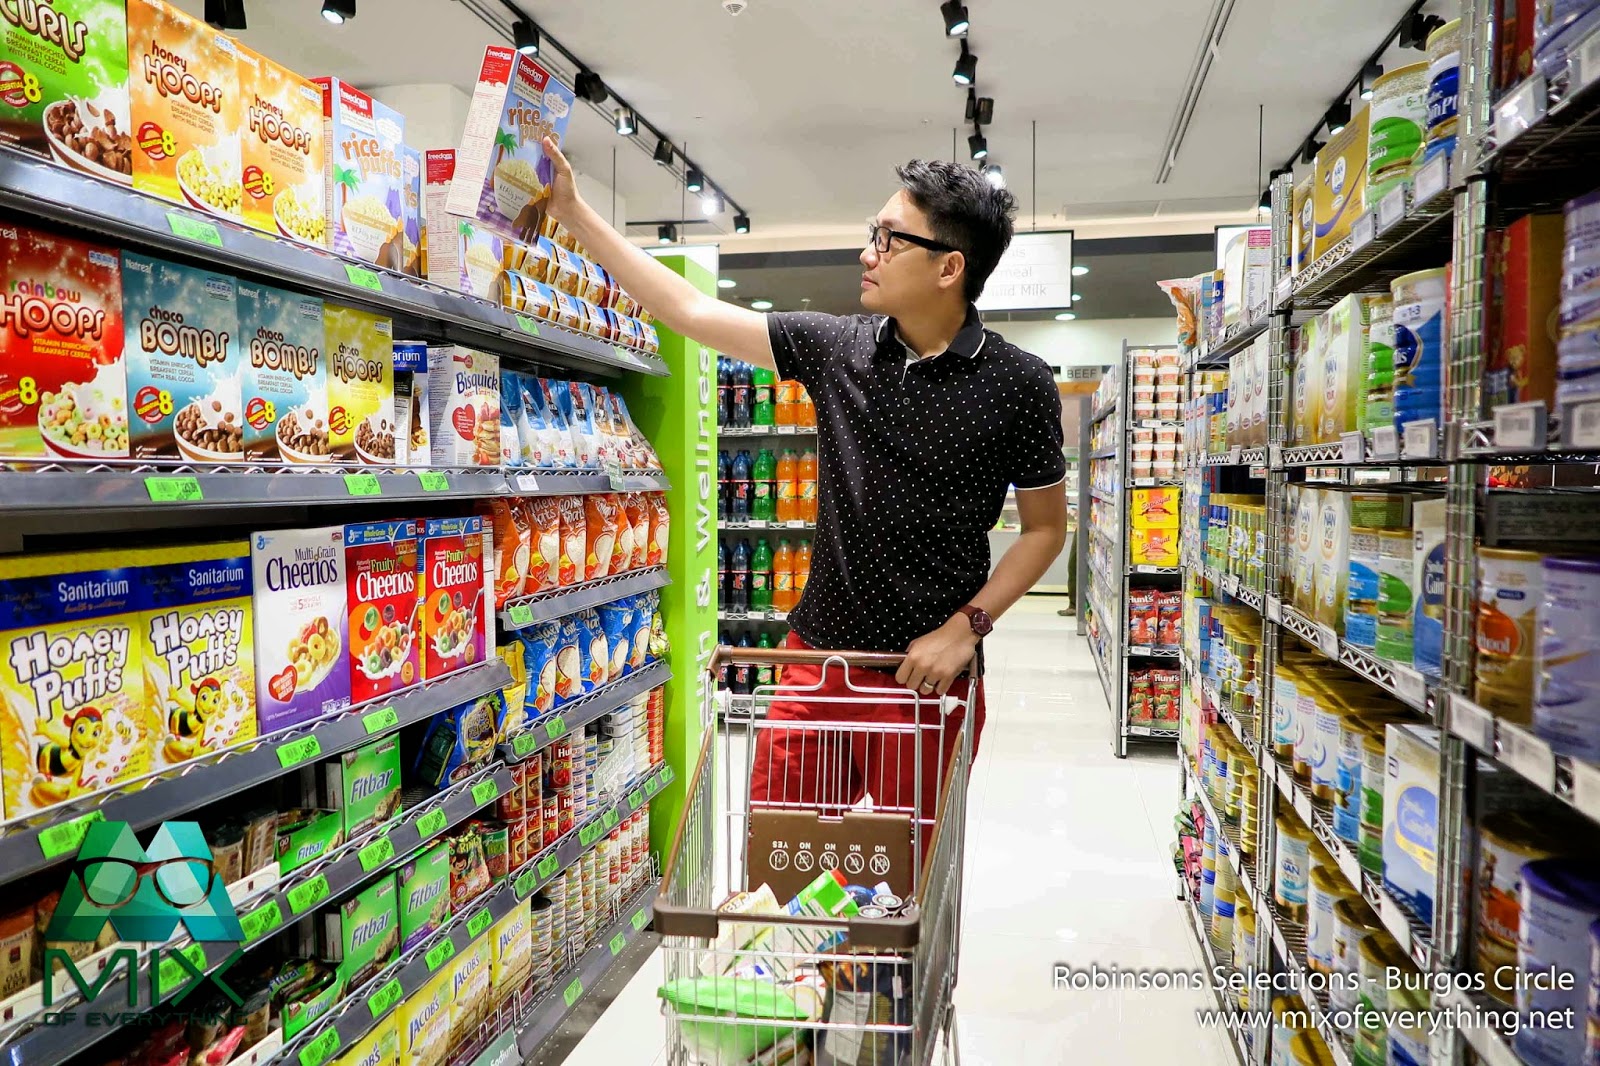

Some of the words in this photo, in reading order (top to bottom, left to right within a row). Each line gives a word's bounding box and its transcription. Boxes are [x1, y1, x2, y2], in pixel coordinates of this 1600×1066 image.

[0, 0, 88, 64] CURLS
[6, 31, 33, 46] VITAMIN
[34, 41, 65, 60] ENRICHED
[6, 37, 42, 57] BREAKFAST
[44, 53, 65, 68] CEREAL
[152, 40, 187, 72] honey
[487, 49, 511, 60] freedom
[7, 46, 26, 59] WITH
[27, 55, 43, 66] REAL
[44, 61, 67, 76] COCOA
[519, 61, 543, 83] freedom
[24, 73, 41, 103] 8
[144, 54, 222, 114] HOOPS
[255, 94, 283, 120] honey
[508, 101, 541, 127] rice
[162, 130, 176, 157] 8
[249, 106, 312, 155] HOOPS
[342, 132, 380, 160] rice
[428, 153, 452, 161] freedom
[361, 149, 401, 182] puffs
[262, 172, 274, 195] 8
[0, 227, 17, 241] real
[10, 278, 81, 304] rainbow
[1021, 284, 1047, 296] Milk
[0, 292, 105, 340] HOOPS
[149, 304, 184, 324] choco
[33, 338, 60, 347] VITAMIN
[61, 341, 92, 351] ENRICHED
[141, 317, 229, 368] BOMBS
[257, 326, 284, 343] choco
[33, 345, 69, 356] BREAKFAST
[70, 350, 92, 359] CEREAL
[250, 337, 319, 381] BOMBS
[339, 342, 359, 357] choco
[393, 350, 421, 362] arium
[149, 358, 170, 367] VITAMIN
[171, 361, 194, 370] ENRICHED
[150, 366, 177, 375] BREAKFAST
[178, 369, 194, 377] CEREAL
[333, 353, 383, 383] HOOPS
[1067, 369, 1097, 379] BEEF
[19, 376, 38, 405] 8
[456, 369, 498, 396] Bisquick
[159, 390, 174, 416] 8
[264, 401, 276, 423] 8
[695, 344, 711, 553] Wellnes
[295, 548, 314, 562] Multi
[318, 545, 336, 559] Grain
[371, 558, 395, 573] Fruity
[446, 550, 463, 564] Fruity
[188, 567, 244, 587] Sanitarium
[266, 557, 338, 592] Cheerios
[356, 570, 414, 602] Cheerios
[433, 561, 477, 588] Cheerios
[58, 579, 129, 603] Sanitarium
[150, 609, 245, 656] Honey
[9, 628, 130, 683] Honey
[165, 632, 237, 691] Puffs
[31, 654, 124, 724] Puffs
[1155, 673, 1179, 682] Hunt's
[350, 768, 393, 806] Fitbar
[297, 839, 323, 862] Fitbar
[772, 841, 788, 849] YES
[799, 842, 811, 850] NO
[824, 843, 836, 851] NO
[849, 844, 861, 852] NO
[874, 845, 886, 853] NO
[408, 877, 445, 913] Fitbar
[351, 909, 391, 953] Fitbar
[497, 913, 523, 962] JACOB'S
[452, 949, 480, 1003] JACOB'S
[406, 993, 440, 1055] JACOB'S
